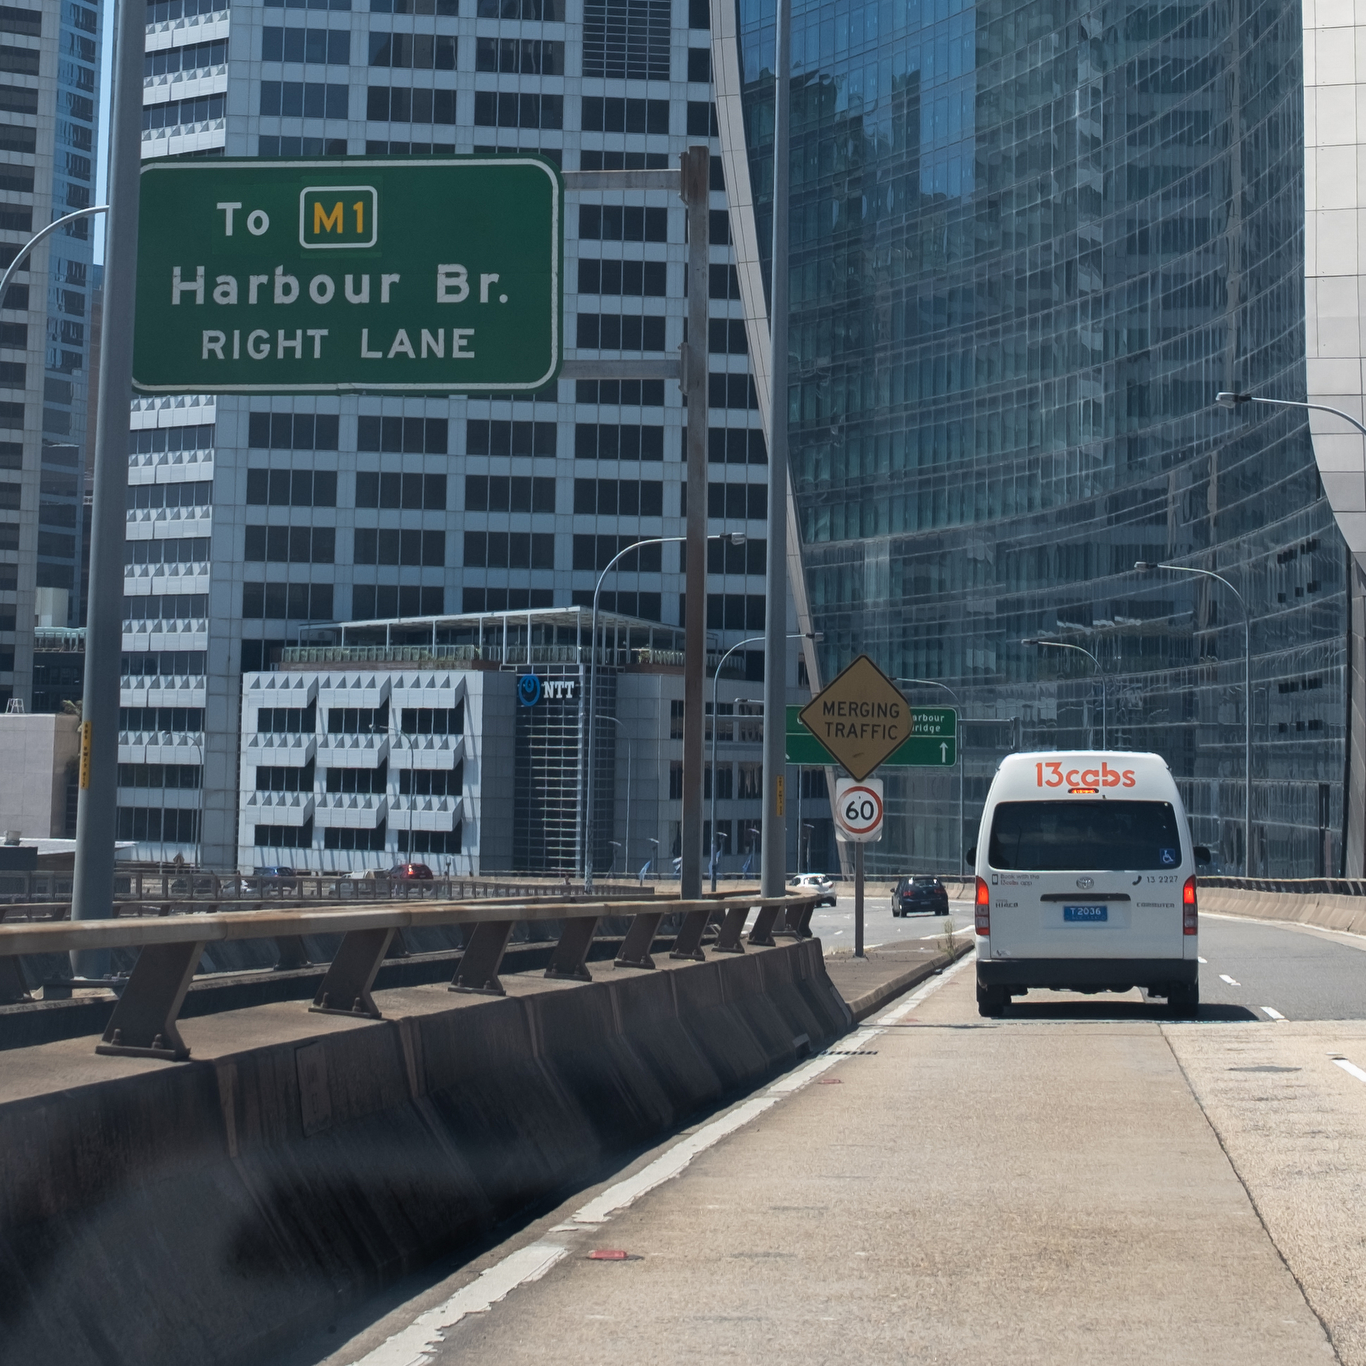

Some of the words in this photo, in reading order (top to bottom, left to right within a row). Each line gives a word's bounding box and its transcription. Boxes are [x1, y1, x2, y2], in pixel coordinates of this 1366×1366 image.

[216, 201, 270, 236] To
[313, 201, 364, 234] M1
[171, 264, 401, 305] Harbour
[436, 263, 508, 304] Br.
[201, 328, 329, 360] RIGHT
[360, 328, 475, 358] LANE
[543, 680, 575, 699] NTT
[822, 700, 900, 719] MERGING
[912, 714, 945, 723] arbour
[824, 721, 898, 741] TRAFFIC
[912, 724, 941, 734] ridge
[1035, 761, 1136, 788] 13cabs
[845, 800, 874, 821] 60
[1147, 875, 1156, 883] 13
[1158, 875, 1178, 883] 2227
